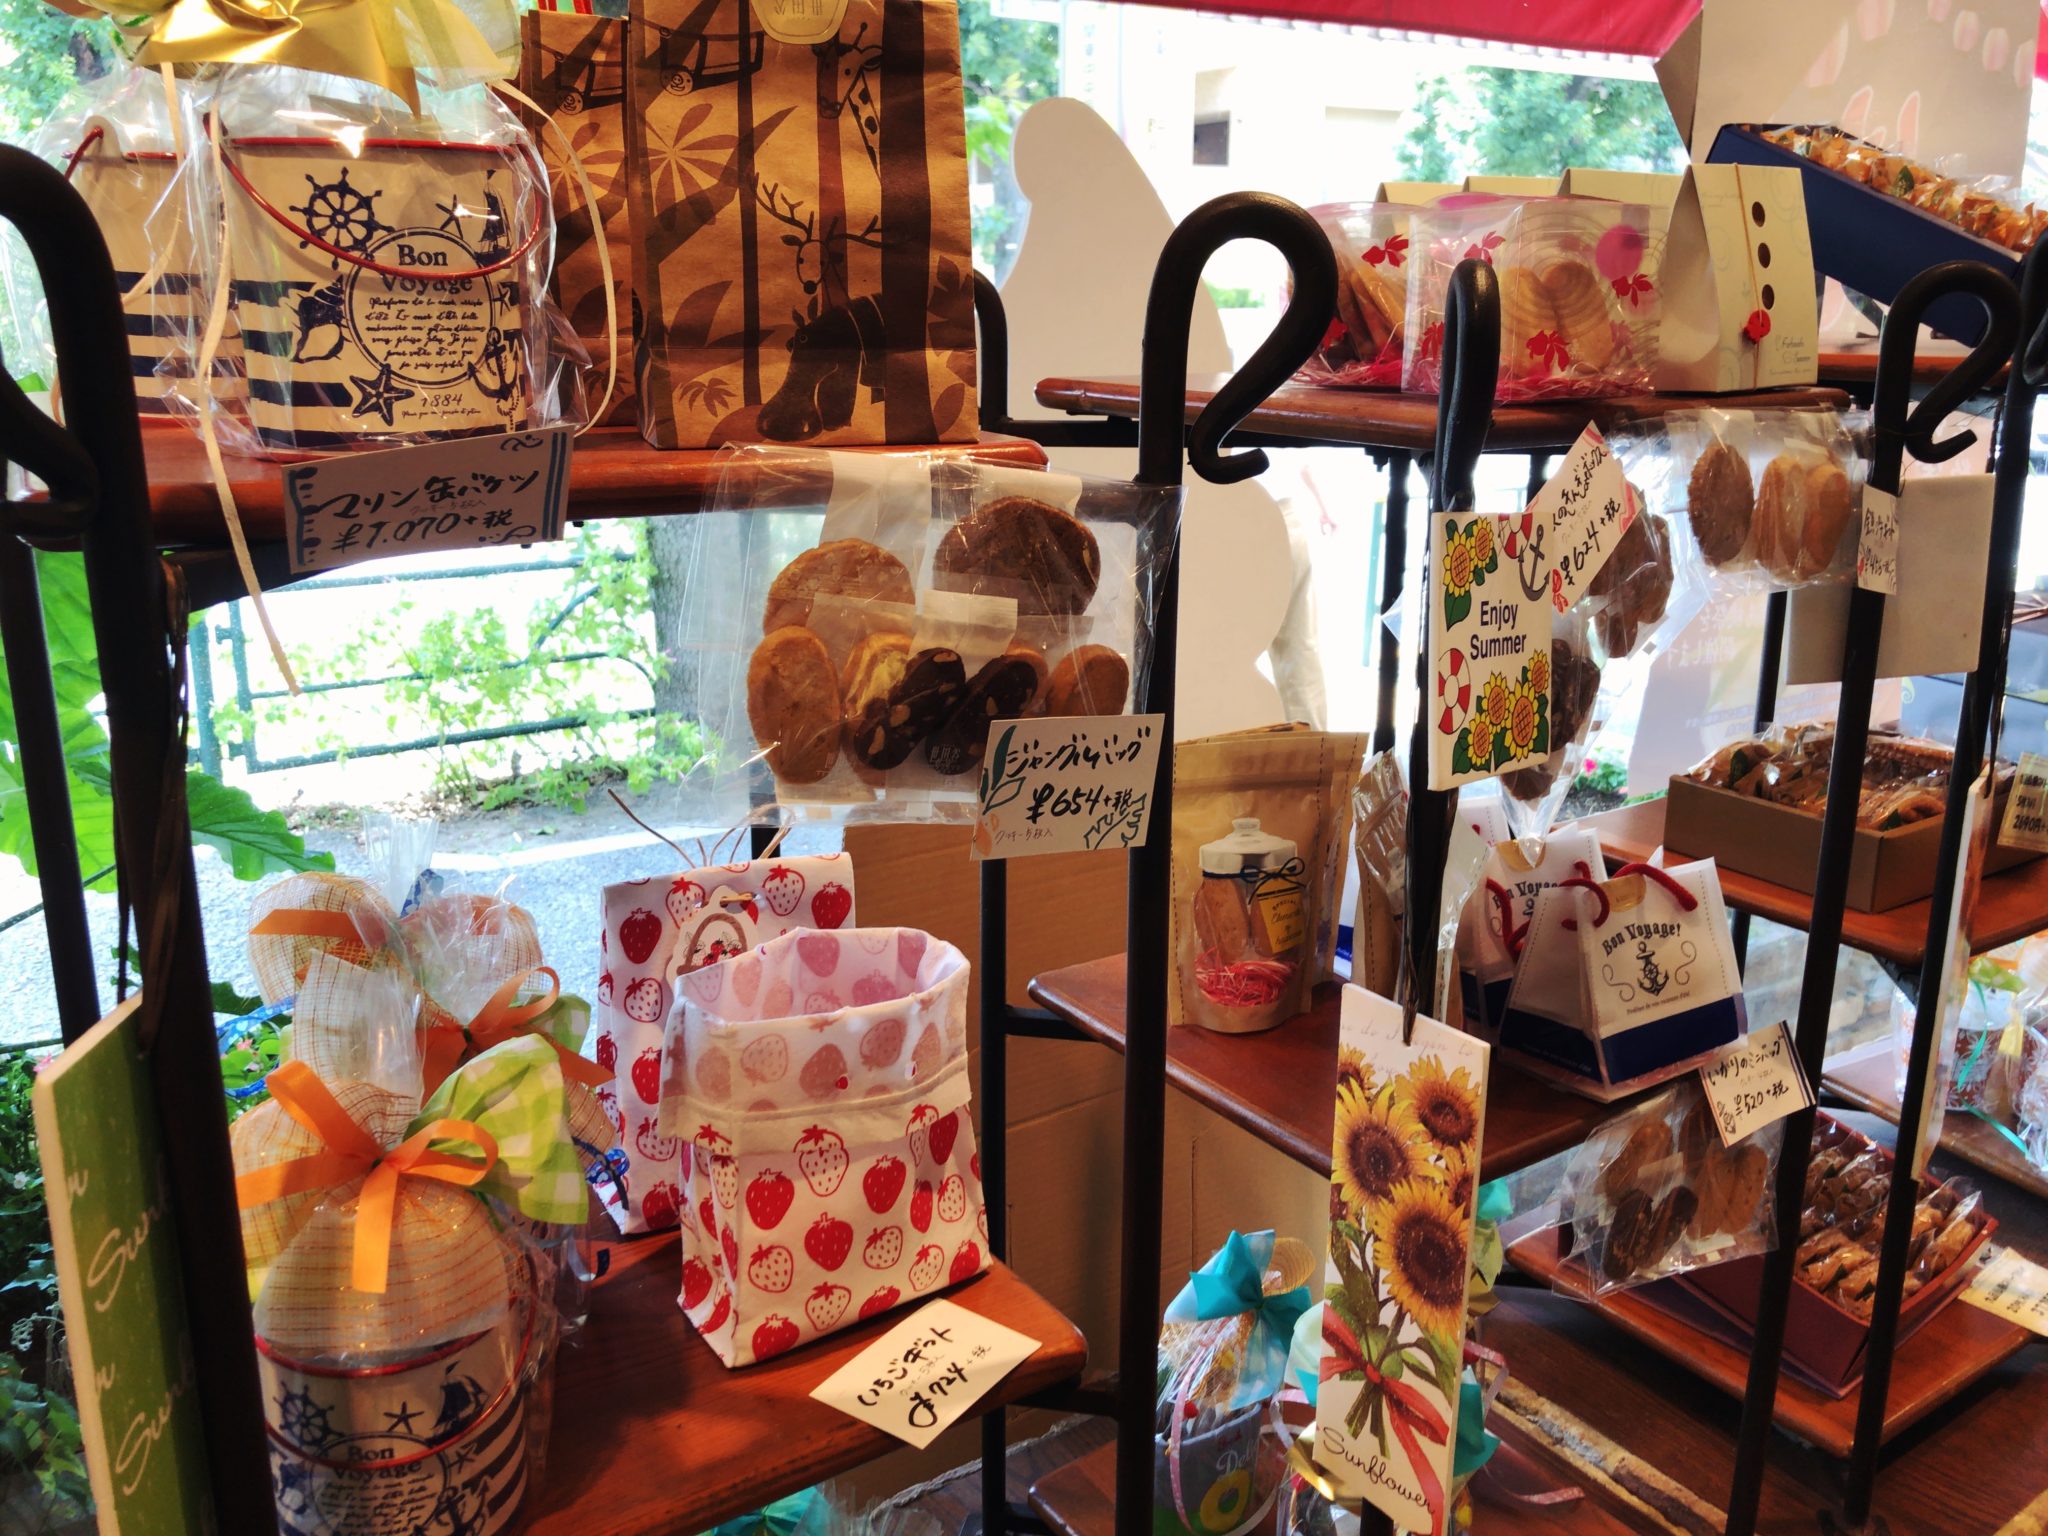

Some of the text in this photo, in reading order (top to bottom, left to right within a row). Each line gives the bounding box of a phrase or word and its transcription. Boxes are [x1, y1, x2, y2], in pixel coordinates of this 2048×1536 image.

[397, 243, 449, 267] Bon
[380, 274, 474, 296] Voyage
[421, 393, 463, 407] 1884
[1480, 599, 1518, 631] Enjoy
[1470, 634, 1527, 660] Summer
[1006, 726, 1151, 778] ジャングルバッグ
[1492, 888, 1515, 911] Bn
[1602, 922, 1682, 957] Bon Voyage!
[349, 1446, 395, 1463] Bon
[1323, 1426, 1436, 1515] Sunflower
